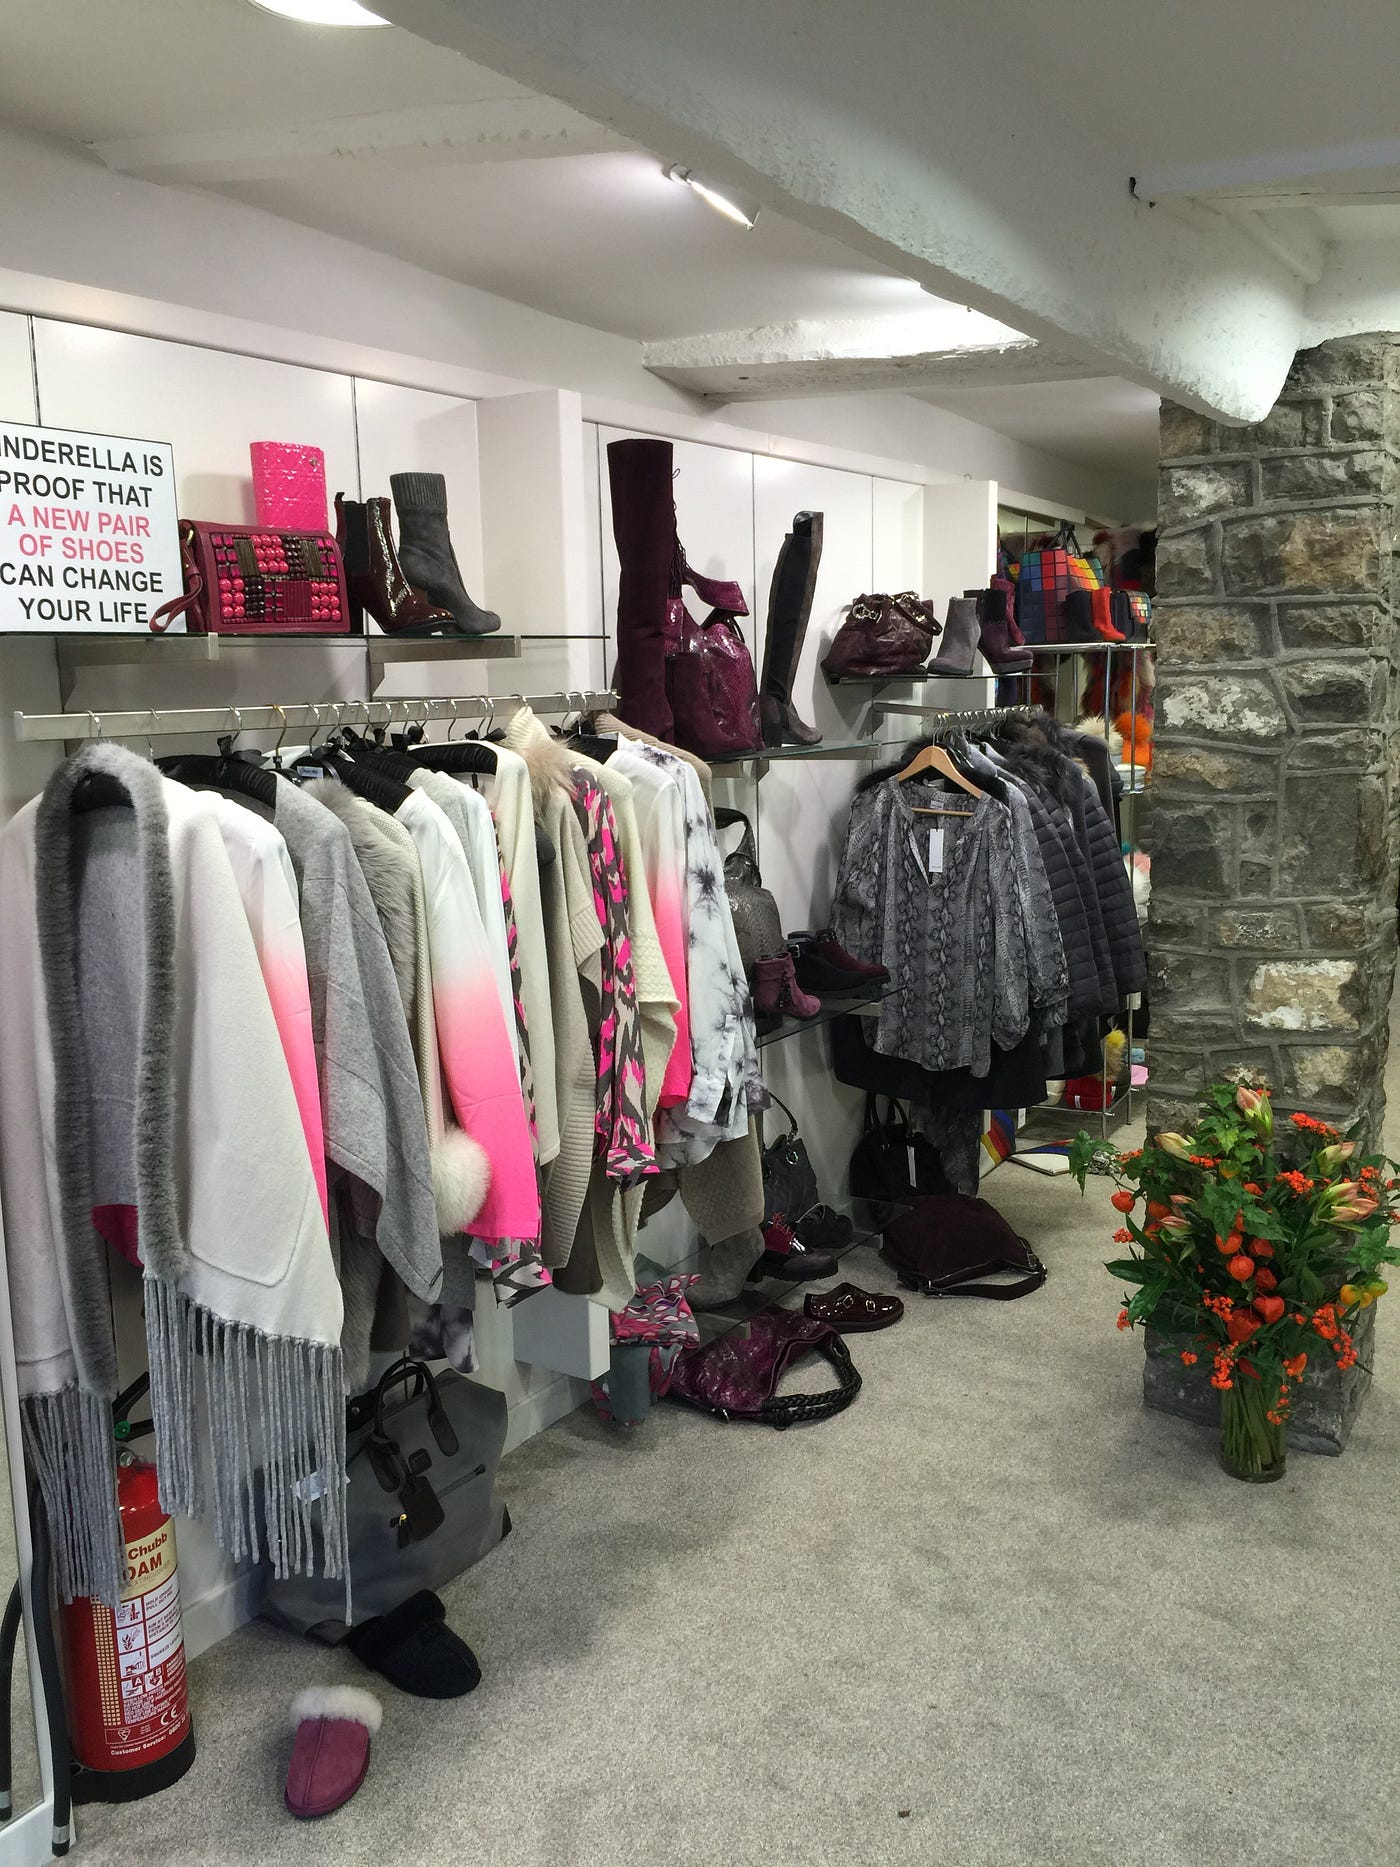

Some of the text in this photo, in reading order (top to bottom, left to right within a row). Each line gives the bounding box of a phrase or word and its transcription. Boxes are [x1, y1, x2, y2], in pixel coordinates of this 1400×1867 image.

[143, 454, 164, 477] IS
[0, 470, 152, 508] PROOF THAT
[7, 503, 151, 538] A NEW PAIR
[19, 533, 145, 564] OF SHOES
[0, 562, 164, 593] CAN CHANGE
[18, 597, 149, 624] YOUR LIFE
[128, 1532, 168, 1560] Chubb
[123, 1552, 162, 1581] OAM
[134, 1677, 143, 1686] A
[155, 1667, 162, 1676] B
[160, 1704, 178, 1726] CE
[110, 1745, 142, 1756] Customer
